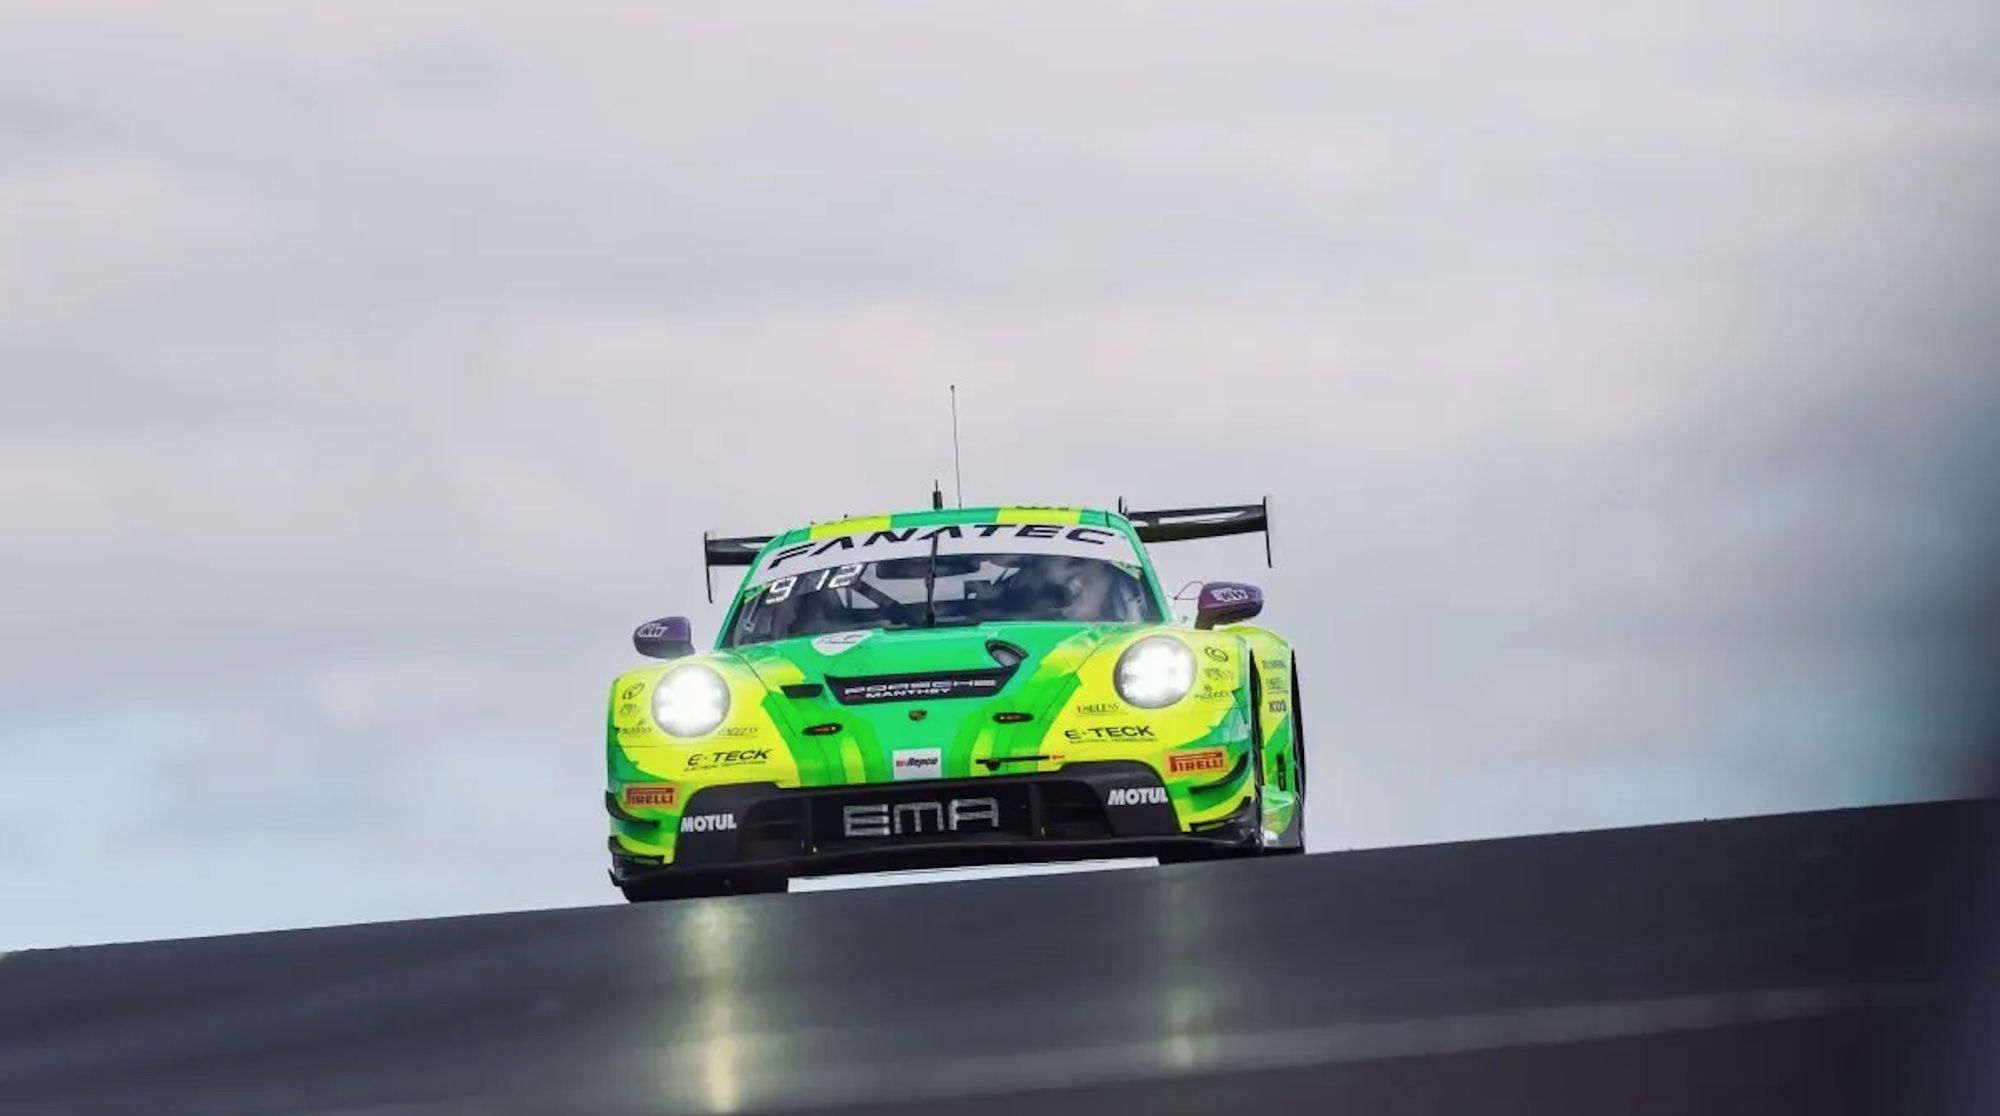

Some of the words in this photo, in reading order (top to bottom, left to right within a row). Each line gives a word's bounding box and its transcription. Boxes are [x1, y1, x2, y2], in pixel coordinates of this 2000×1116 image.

[768, 524, 1115, 570] FANATEC
[845, 680, 996, 695] PORSCHE
[865, 688, 950, 698] MANTHEY
[1168, 751, 1223, 772] PIRELLI
[1108, 786, 1167, 806] MOTUL
[681, 813, 737, 832] MOTUL
[842, 796, 1000, 837] EMA
